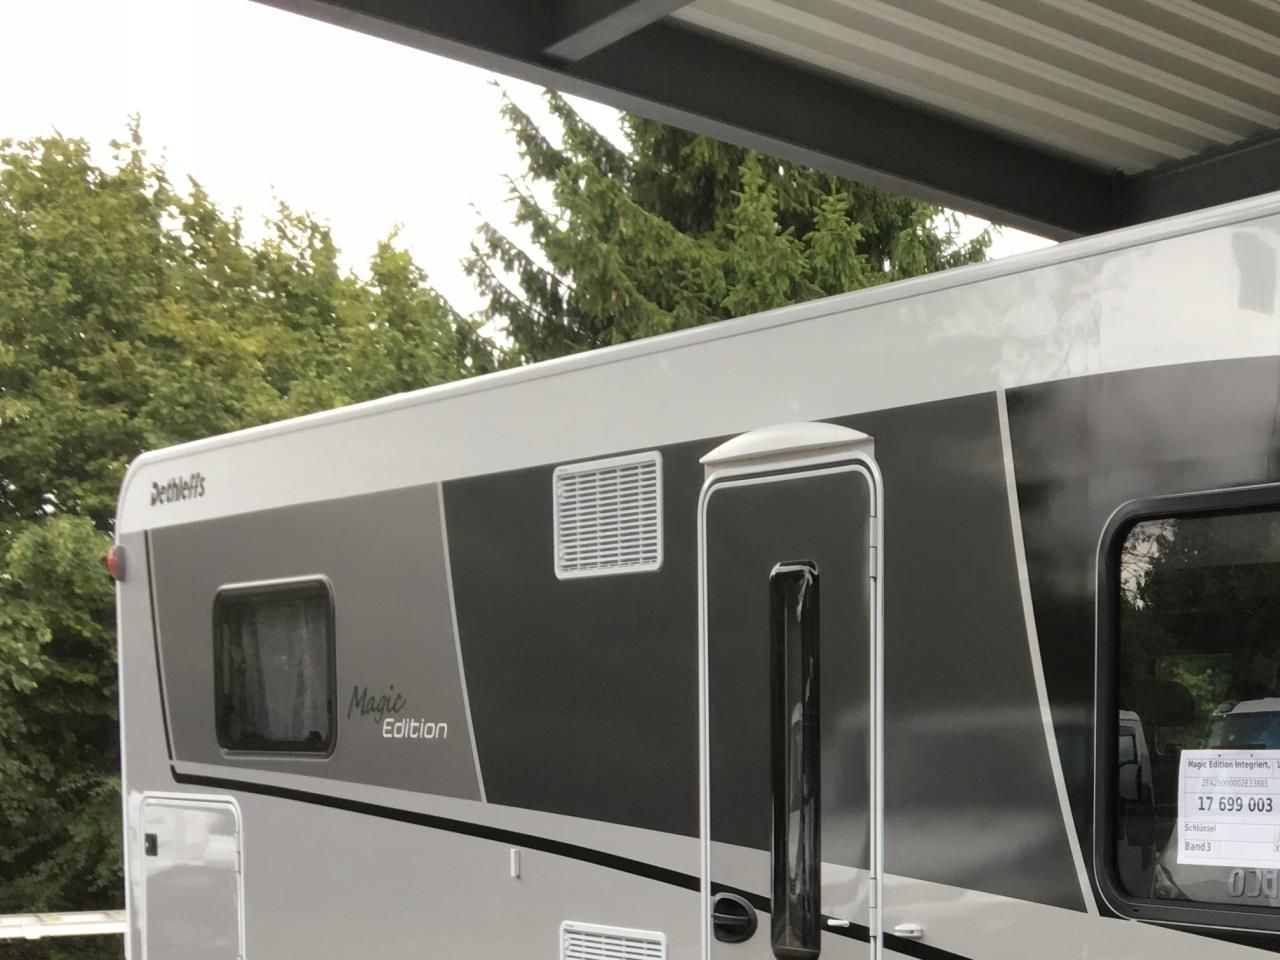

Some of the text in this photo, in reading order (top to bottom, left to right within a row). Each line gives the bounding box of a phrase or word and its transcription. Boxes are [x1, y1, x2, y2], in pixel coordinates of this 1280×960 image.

[150, 472, 206, 507] Dethleffs
[347, 684, 407, 724] Magic
[382, 718, 448, 739] Edition
[1188, 760, 1207, 770] Magic
[1209, 760, 1233, 769] Edition
[1198, 796, 1273, 813] 17 699 003
[1184, 823, 1216, 833] Schlüssel
